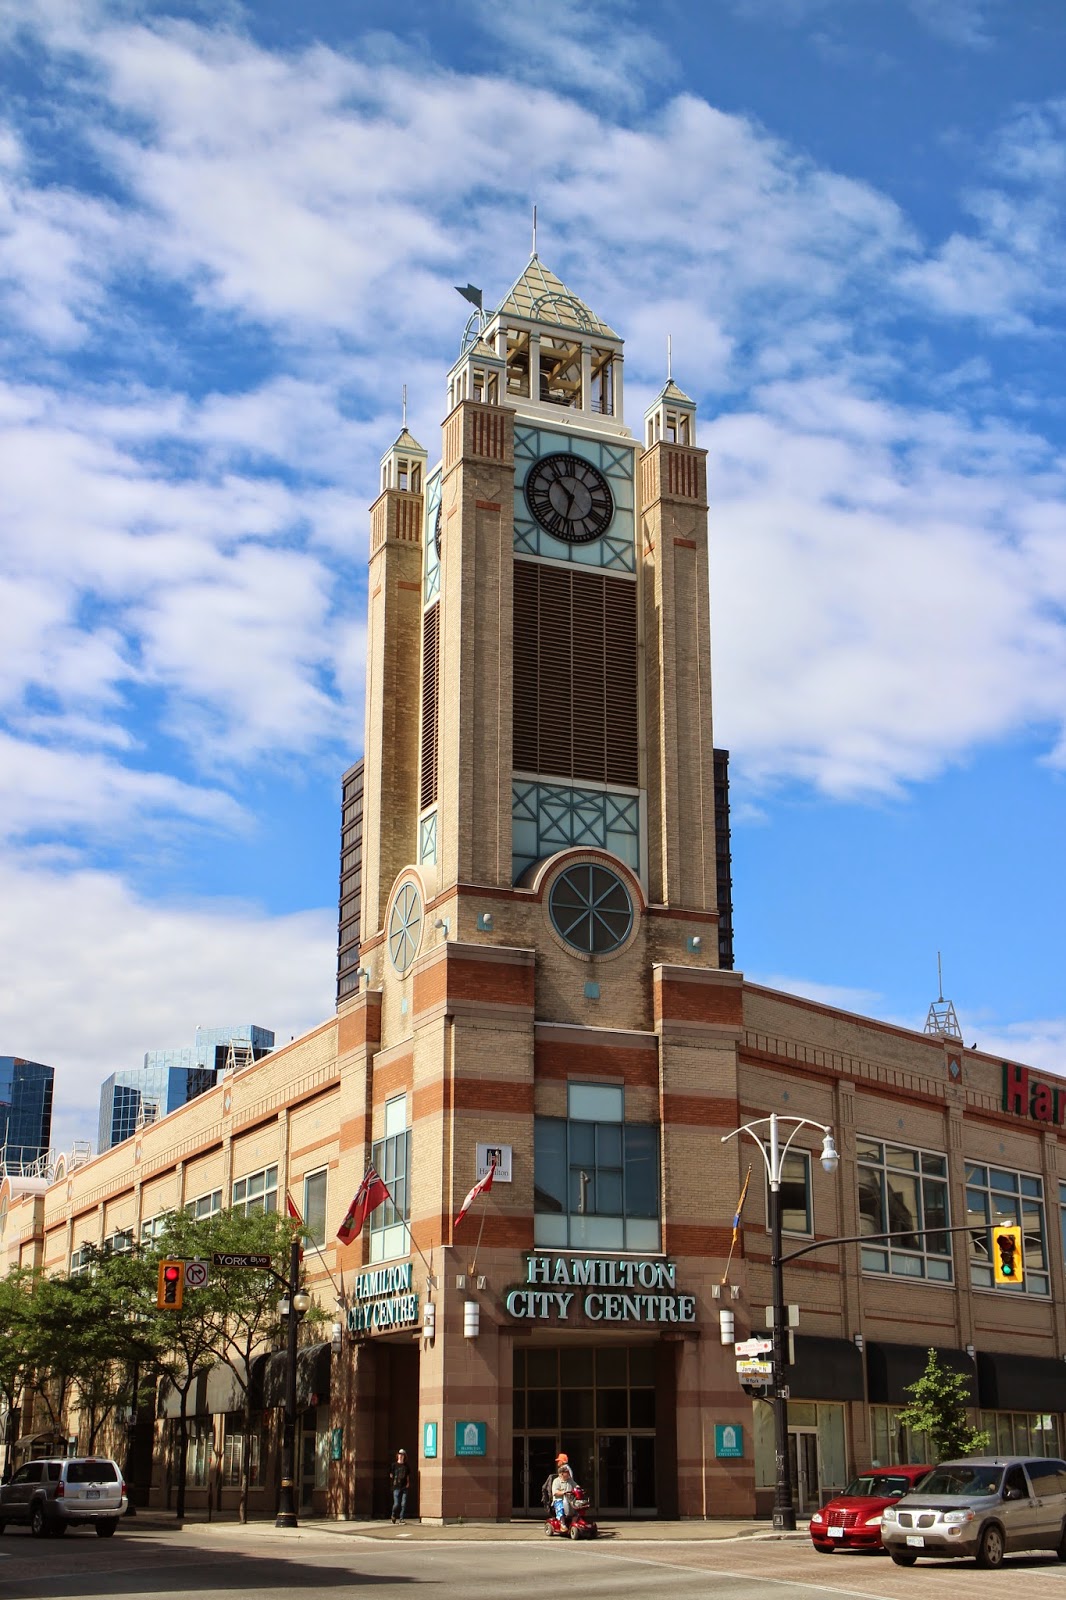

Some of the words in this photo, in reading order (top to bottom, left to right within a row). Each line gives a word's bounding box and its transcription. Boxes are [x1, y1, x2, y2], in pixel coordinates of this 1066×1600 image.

[479, 1167, 509, 1176] Hailton
[355, 1262, 413, 1299] HAMILTON
[526, 1256, 677, 1290] HAMILTON
[347, 1302, 372, 1332] CITY
[373, 1293, 419, 1328] CENTRE
[506, 1290, 574, 1319] CITY
[584, 1294, 696, 1323] CENTRE
